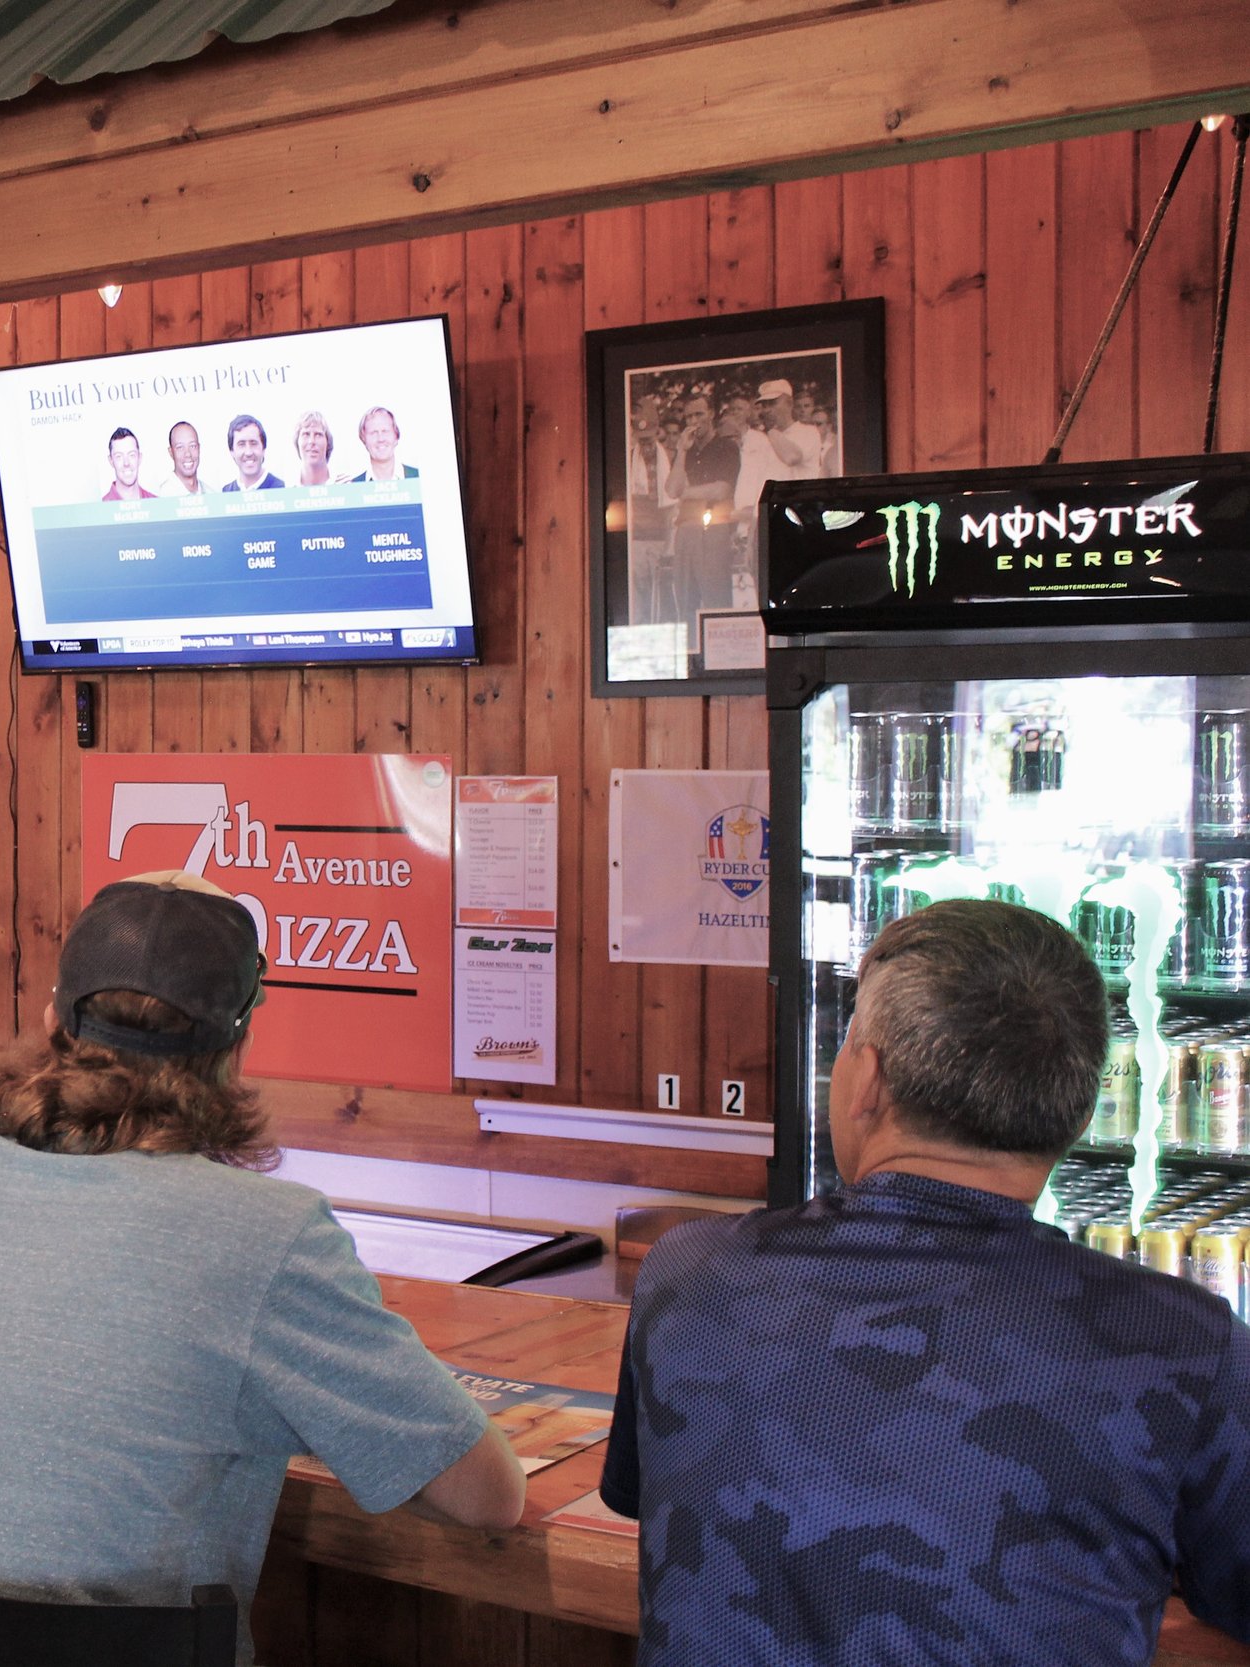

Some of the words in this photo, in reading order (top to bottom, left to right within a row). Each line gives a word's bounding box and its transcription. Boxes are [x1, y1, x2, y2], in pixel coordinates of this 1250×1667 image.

[28, 383, 85, 411] Build
[91, 380, 146, 402] Your
[153, 374, 206, 397] Own
[215, 364, 291, 390] Player
[960, 502, 1203, 548] MONSTER
[243, 541, 276, 555] SHORT
[301, 536, 345, 551] PUTTING
[372, 533, 412, 547] MENTAL
[118, 548, 156, 561] DRIVING
[182, 545, 212, 558] IRONS
[365, 549, 424, 563] TOUGHNESS
[996, 548, 1163, 571] ENERGY
[248, 557, 276, 569] GAME
[108, 782, 270, 878] 7th
[274, 841, 412, 888] Avenue
[704, 861, 750, 876] RYDER
[751, 861, 770, 876] CU
[731, 881, 753, 891] 2016
[698, 912, 770, 929] HAZELTI
[467, 936, 510, 952] GOLF
[510, 937, 554, 954] ZONE
[476, 1036, 540, 1051] Brown's
[664, 1077, 674, 1106] 1
[726, 1083, 741, 1114] 2
[451, 1371, 535, 1393] LEVATE
